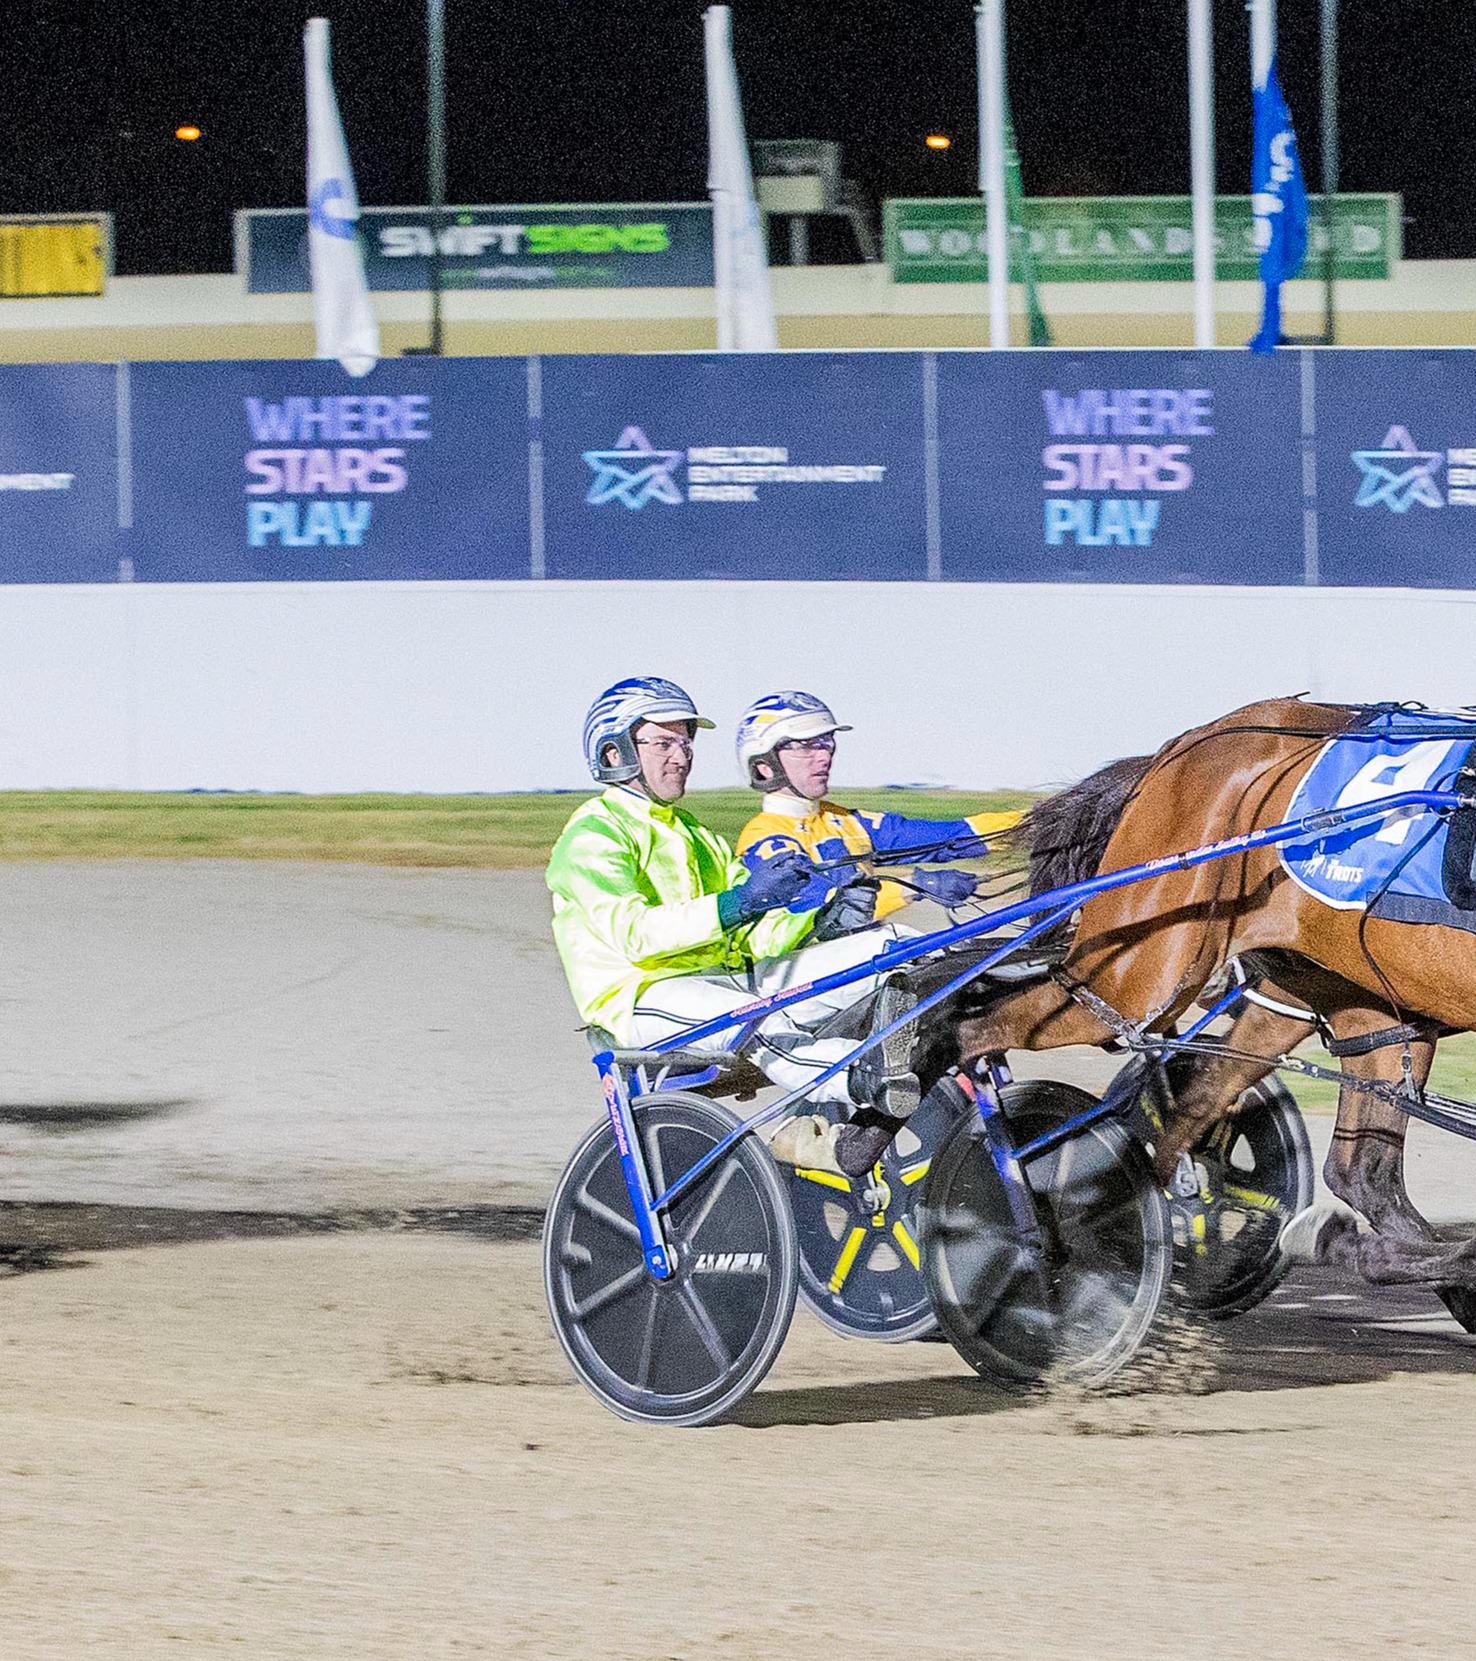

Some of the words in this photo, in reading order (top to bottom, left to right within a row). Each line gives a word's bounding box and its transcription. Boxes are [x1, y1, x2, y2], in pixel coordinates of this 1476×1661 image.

[245, 395, 431, 440] WHERE
[1042, 389, 1214, 436] WHERE
[244, 449, 408, 494] STARS
[1042, 444, 1193, 491] STARS
[246, 501, 371, 547] PLAY
[1044, 499, 1160, 546] PLAY
